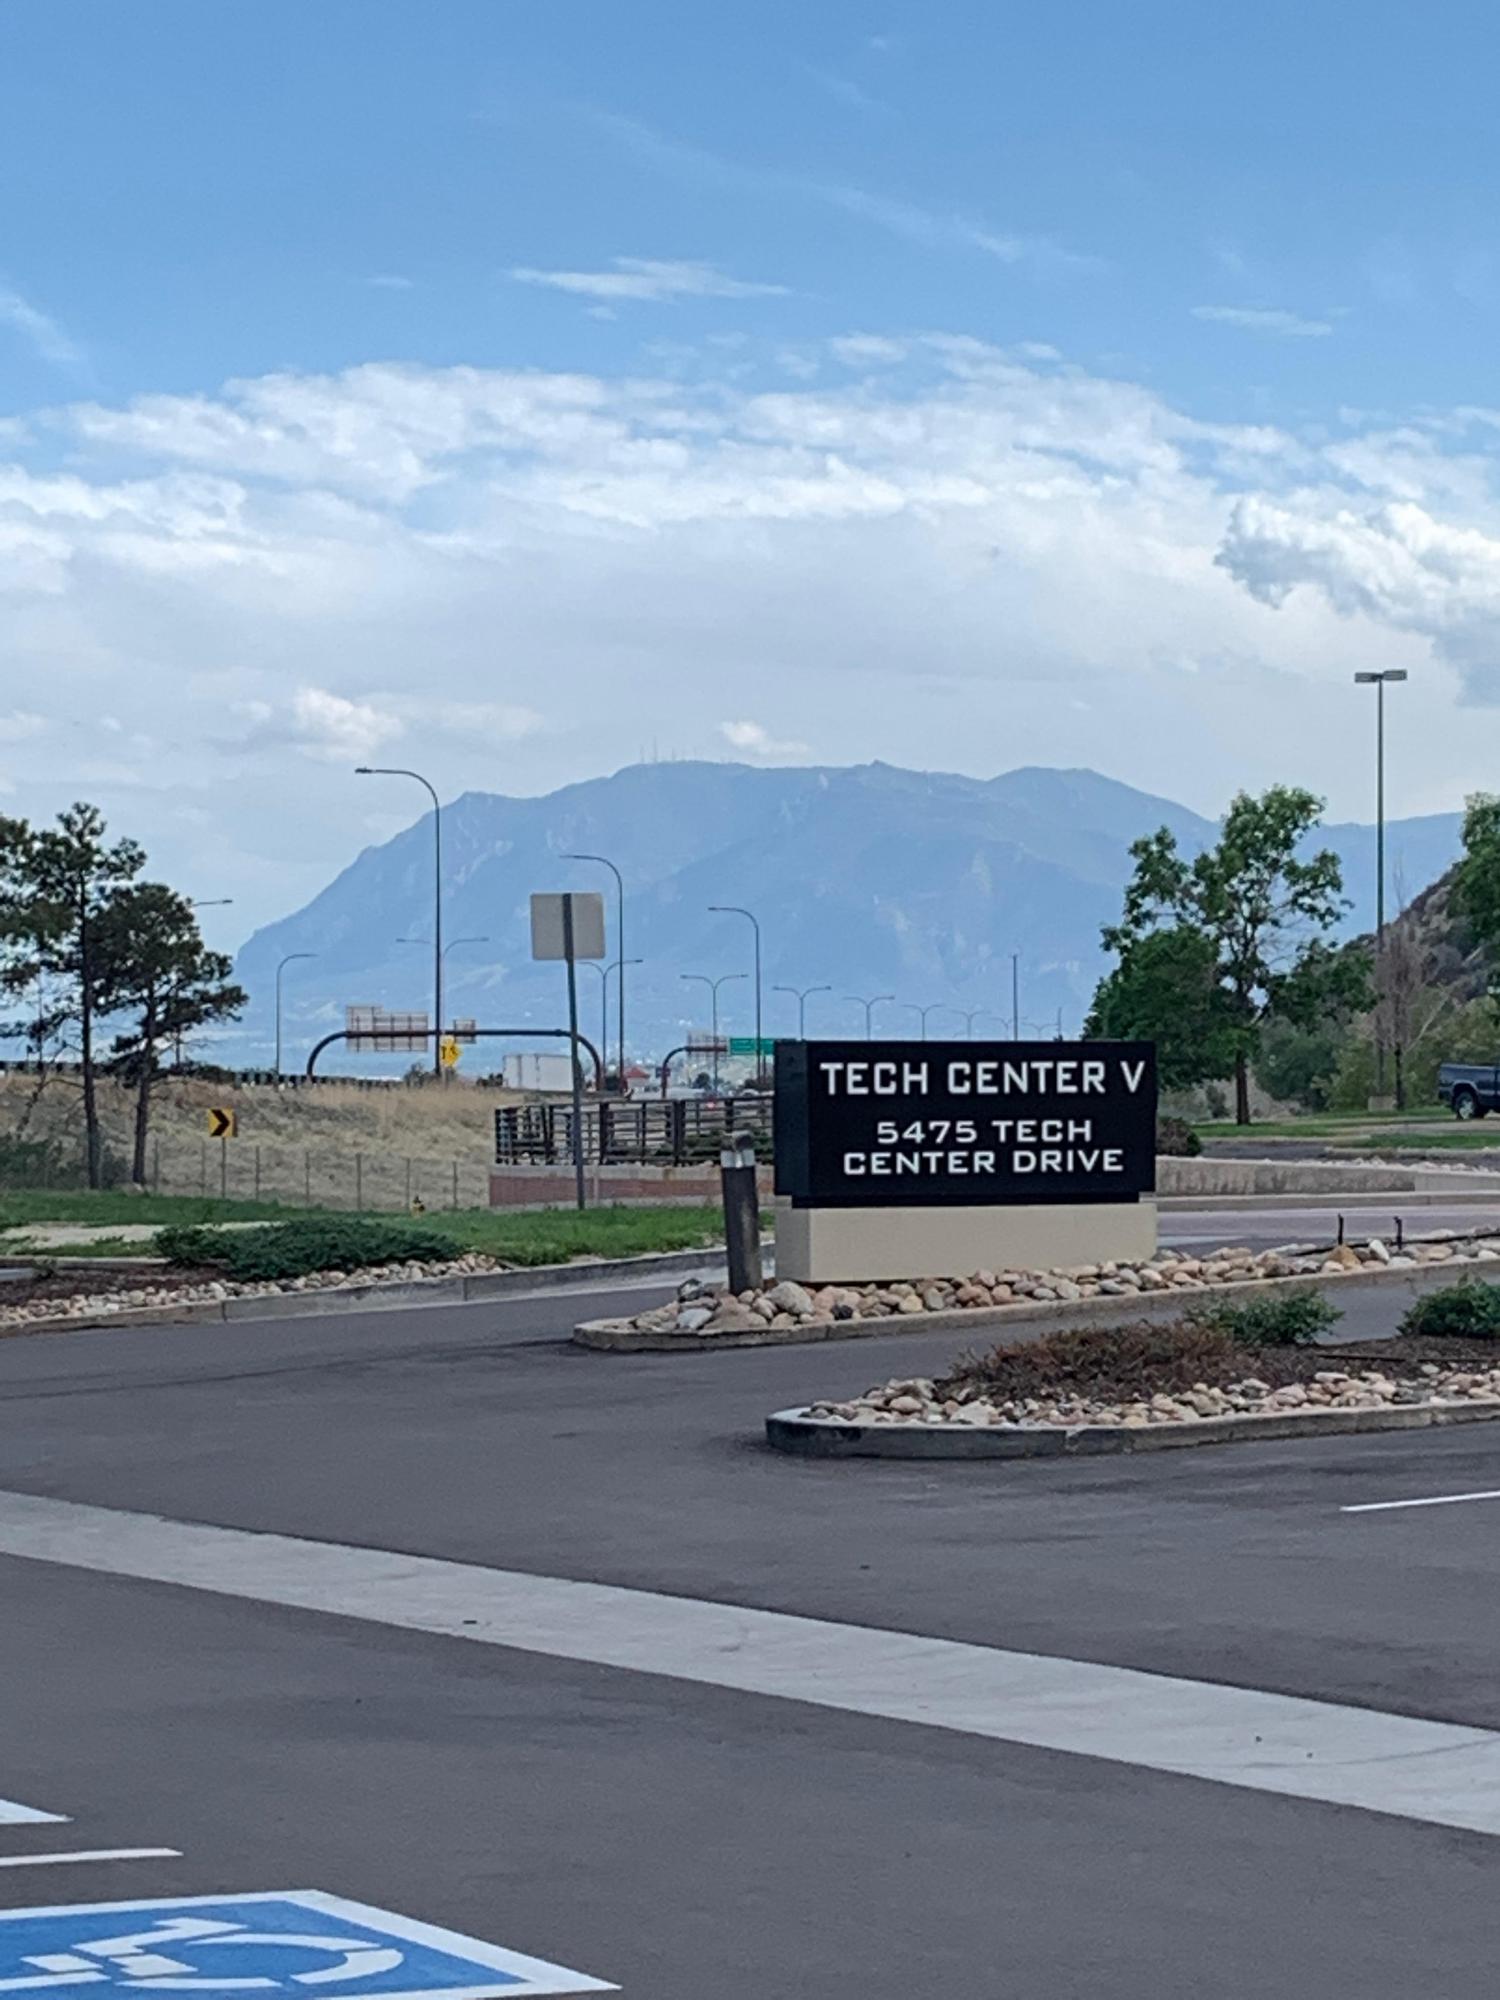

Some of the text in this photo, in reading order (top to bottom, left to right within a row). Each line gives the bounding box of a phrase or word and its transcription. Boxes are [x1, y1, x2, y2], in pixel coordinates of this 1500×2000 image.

[820, 1060, 1145, 1095] TECH CENTER V
[877, 1119, 1091, 1144] 5475 TECH
[843, 1149, 1123, 1175] CENTER DRIVE
